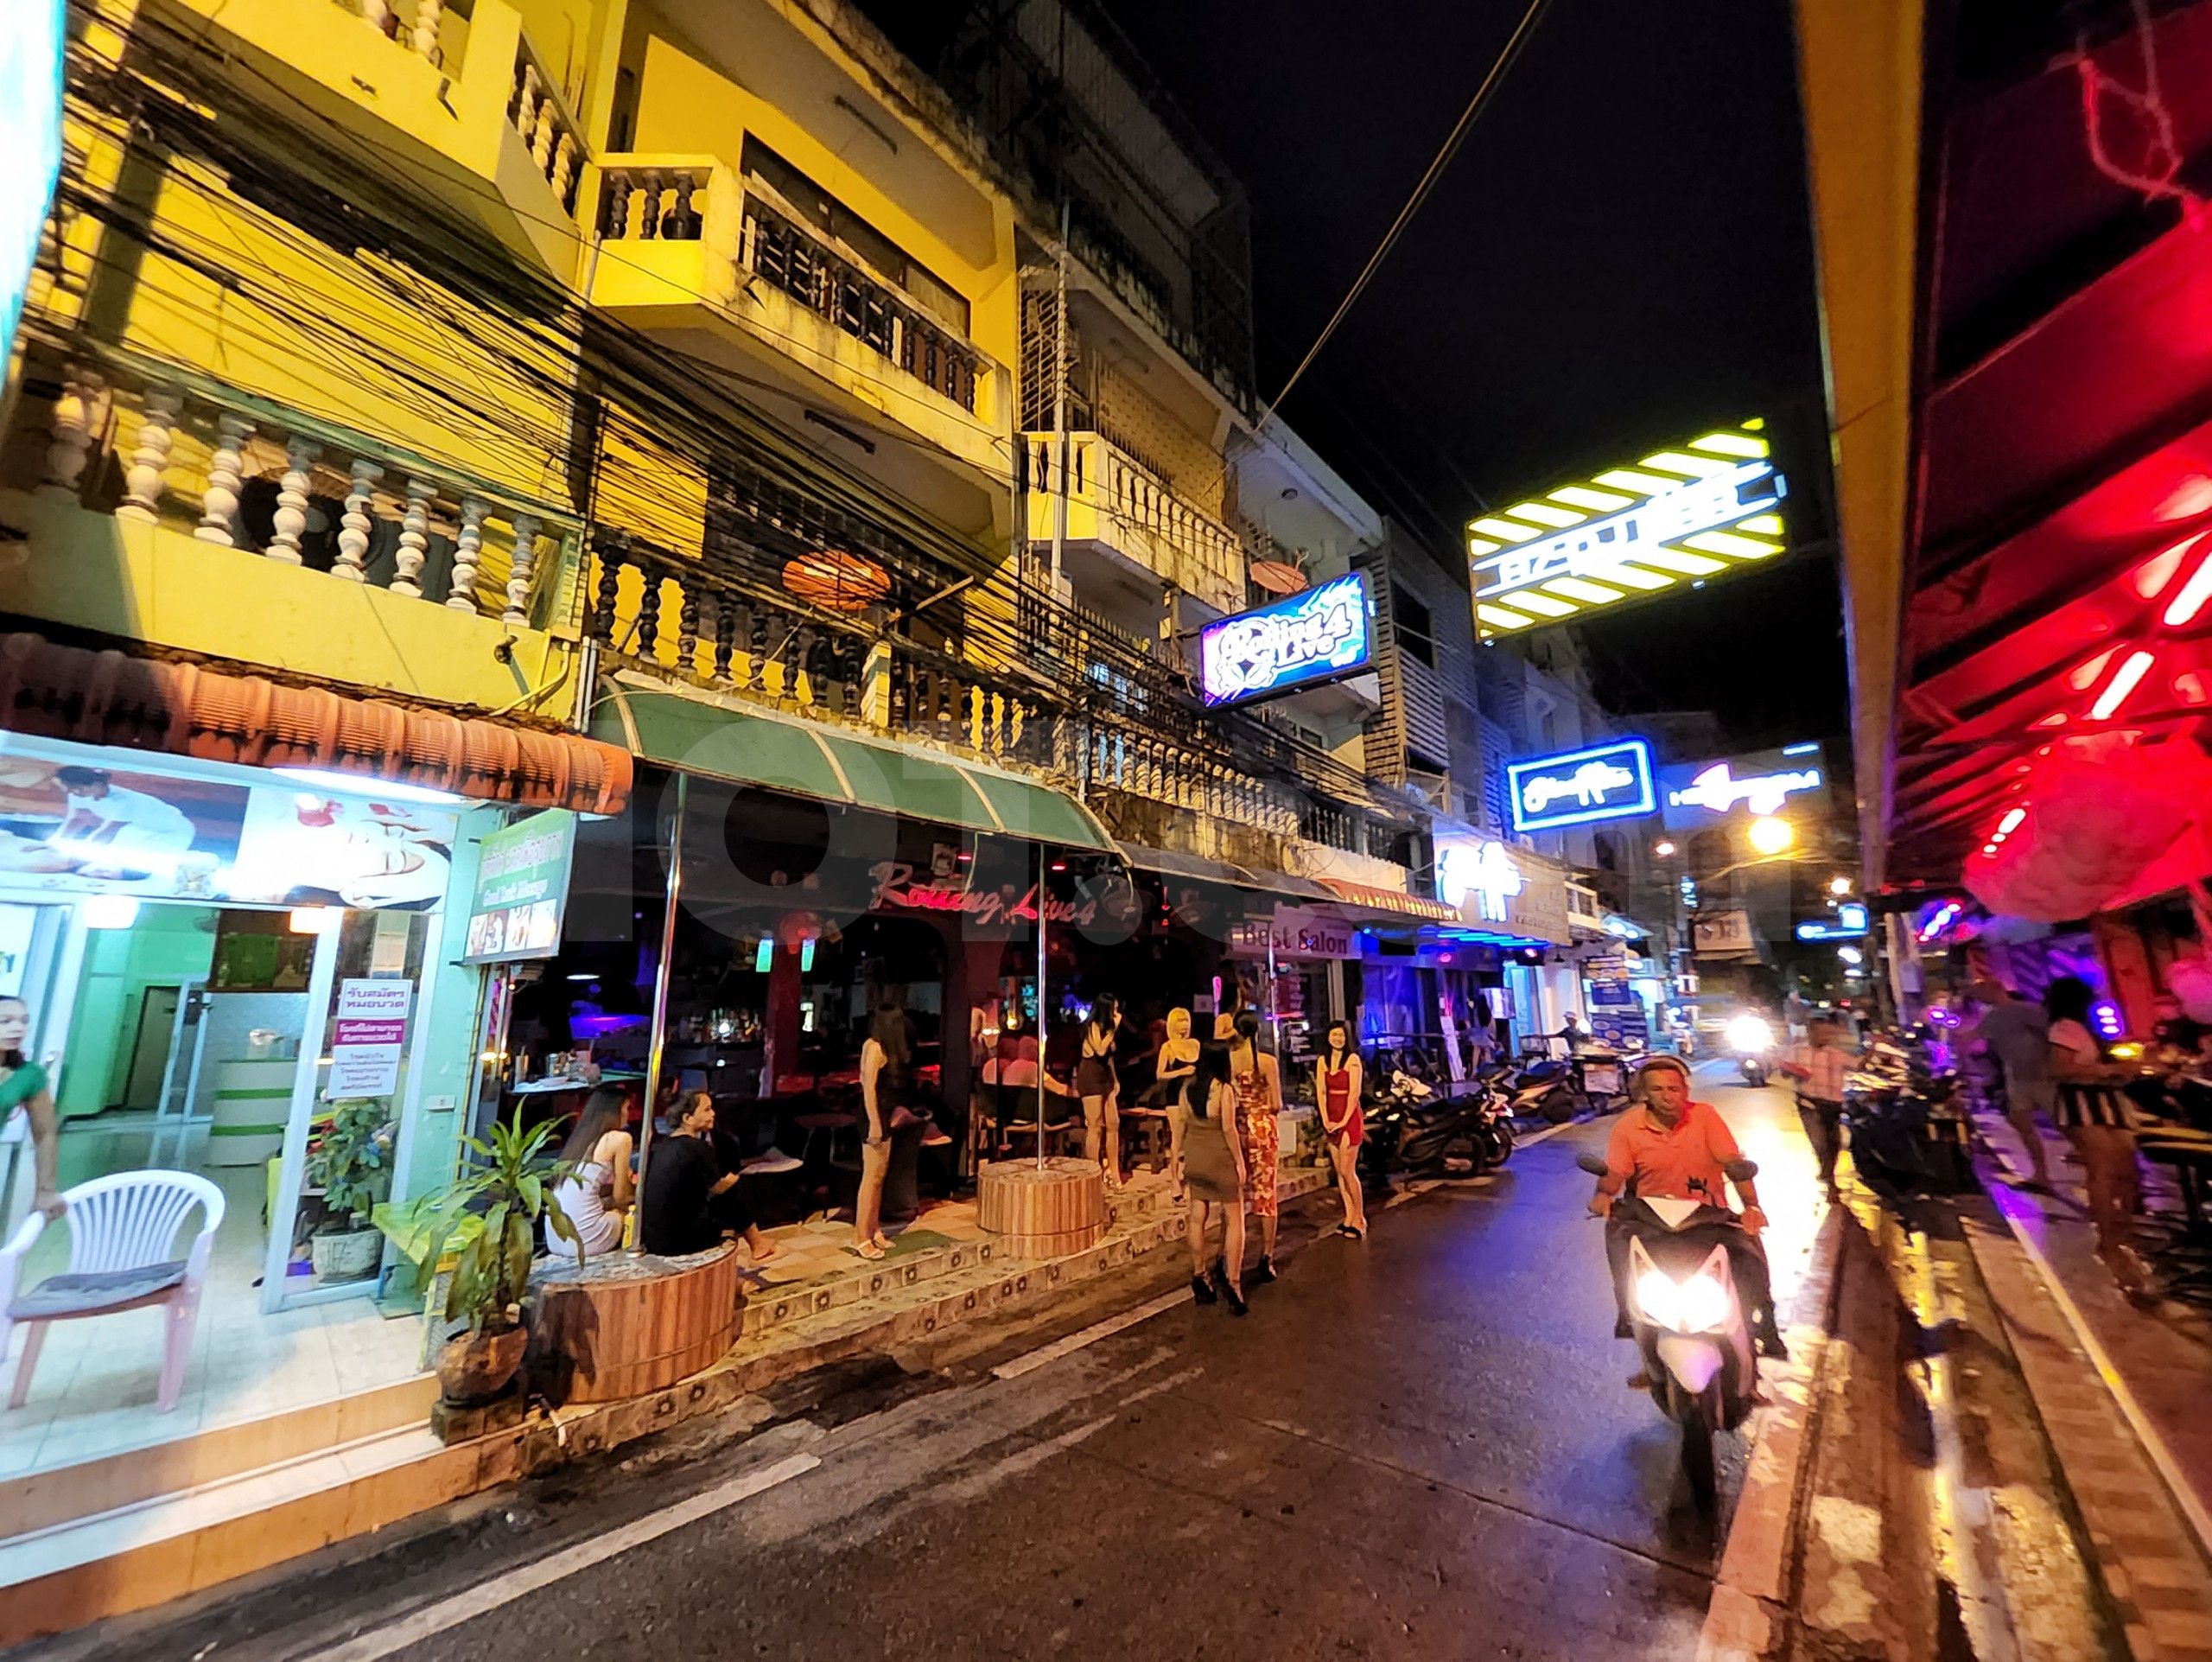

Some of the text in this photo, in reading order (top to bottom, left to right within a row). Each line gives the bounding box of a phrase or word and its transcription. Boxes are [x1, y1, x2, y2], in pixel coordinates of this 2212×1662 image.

[1298, 927, 1348, 954] Salon
[347, 987, 404, 998] รับสมัคร
